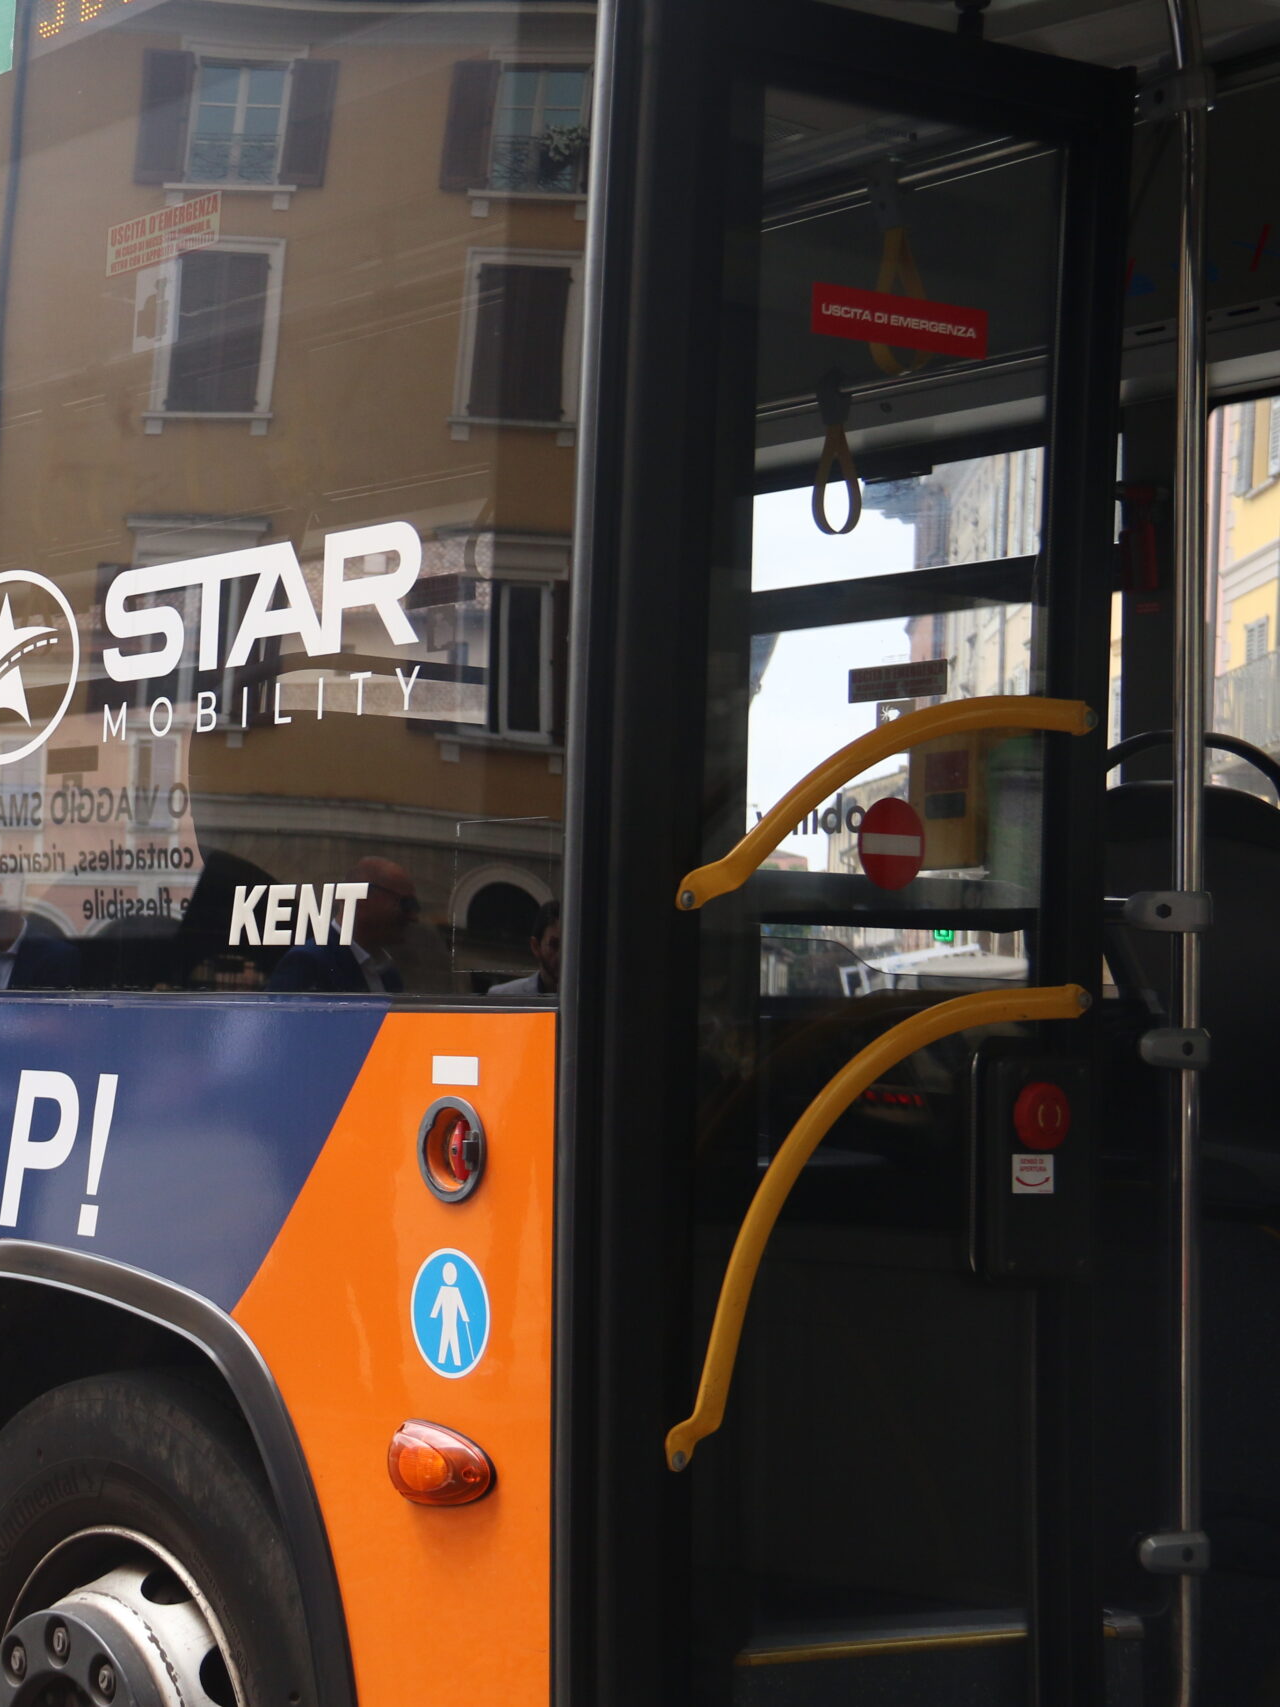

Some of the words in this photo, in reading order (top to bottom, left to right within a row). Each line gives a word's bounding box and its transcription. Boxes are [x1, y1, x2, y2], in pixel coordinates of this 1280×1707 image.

[111, 218, 146, 247] USCITA
[149, 194, 218, 234] D'EMERGENZA
[821, 303, 872, 323] USCITA
[874, 311, 888, 325] DI
[890, 315, 977, 340] EMERGENZA
[102, 521, 423, 682] STAR
[102, 665, 420, 743] MOBILITY
[229, 882, 369, 947] KENT
